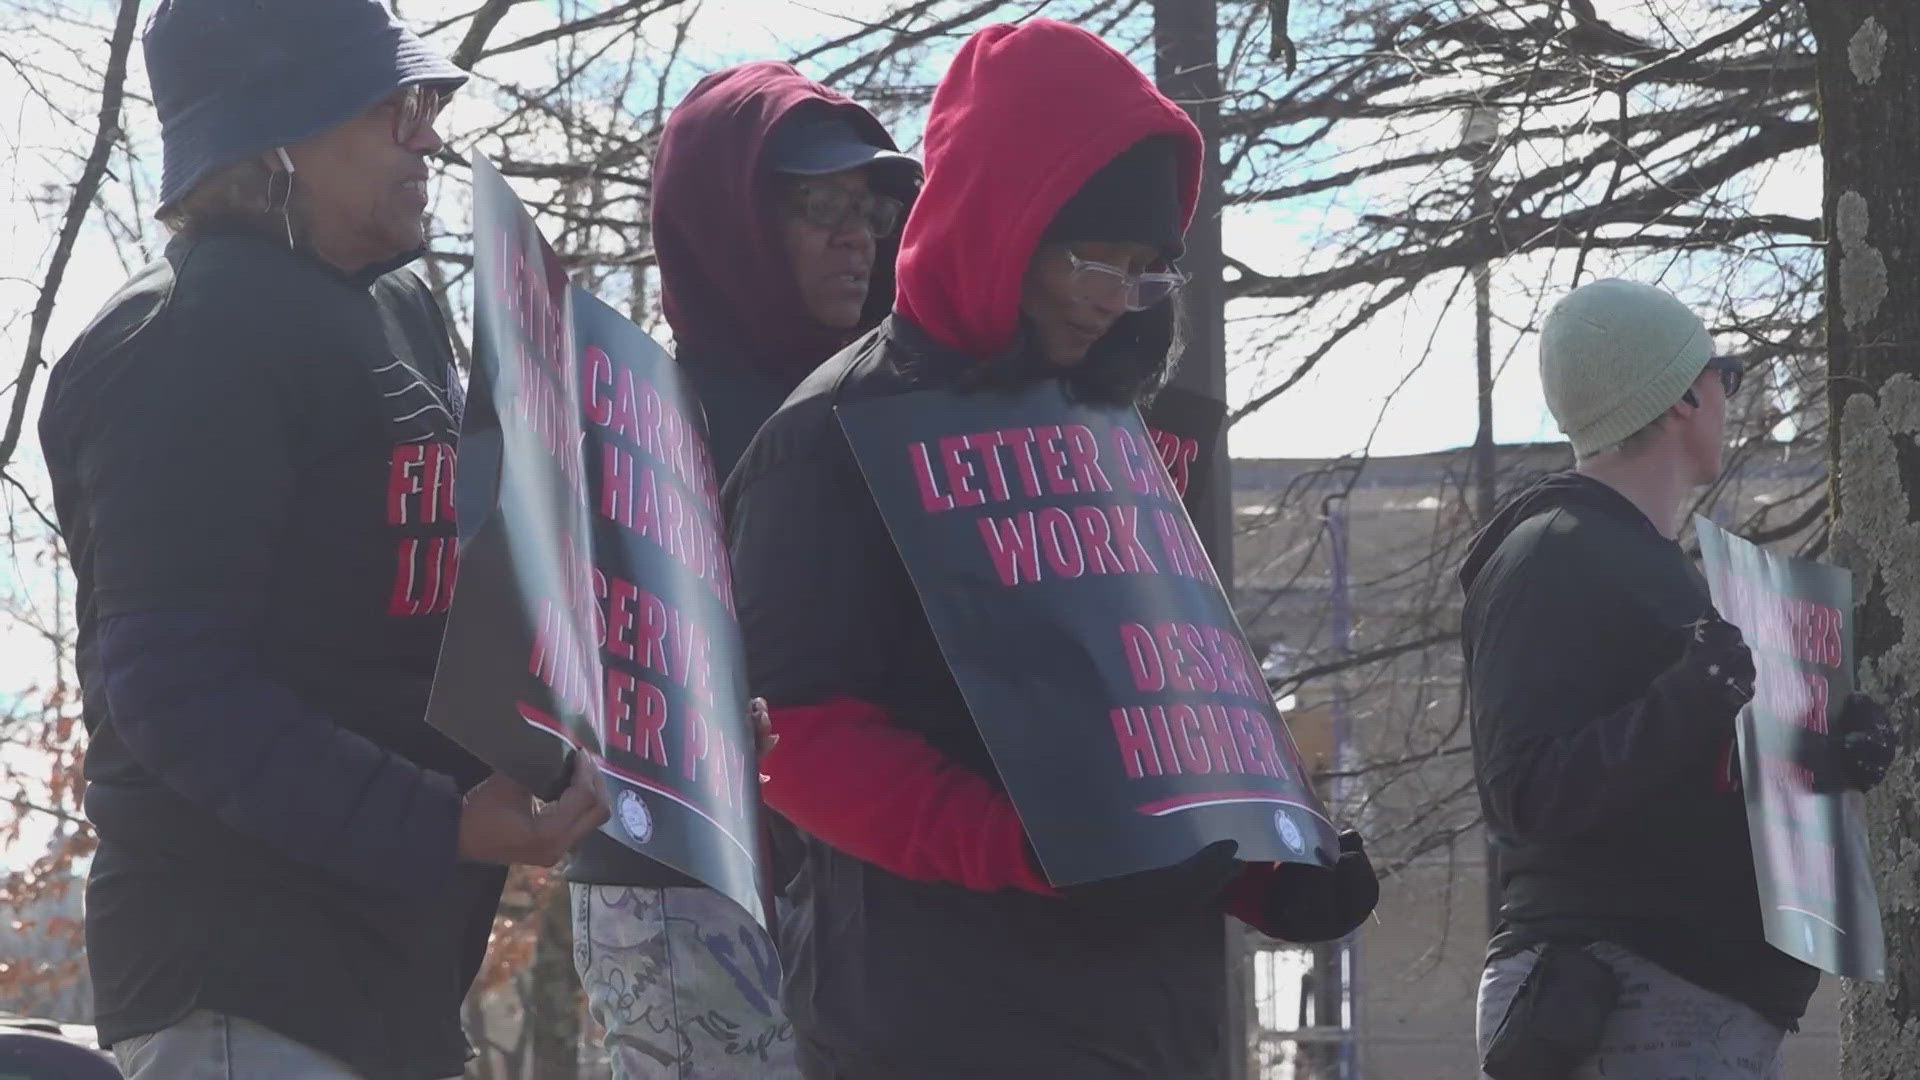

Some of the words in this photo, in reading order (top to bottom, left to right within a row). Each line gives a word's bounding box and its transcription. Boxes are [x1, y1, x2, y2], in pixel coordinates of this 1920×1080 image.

[908, 424, 1113, 513] LETTER
[978, 504, 1159, 587] WORK
[1110, 704, 1290, 780] HIGHER
